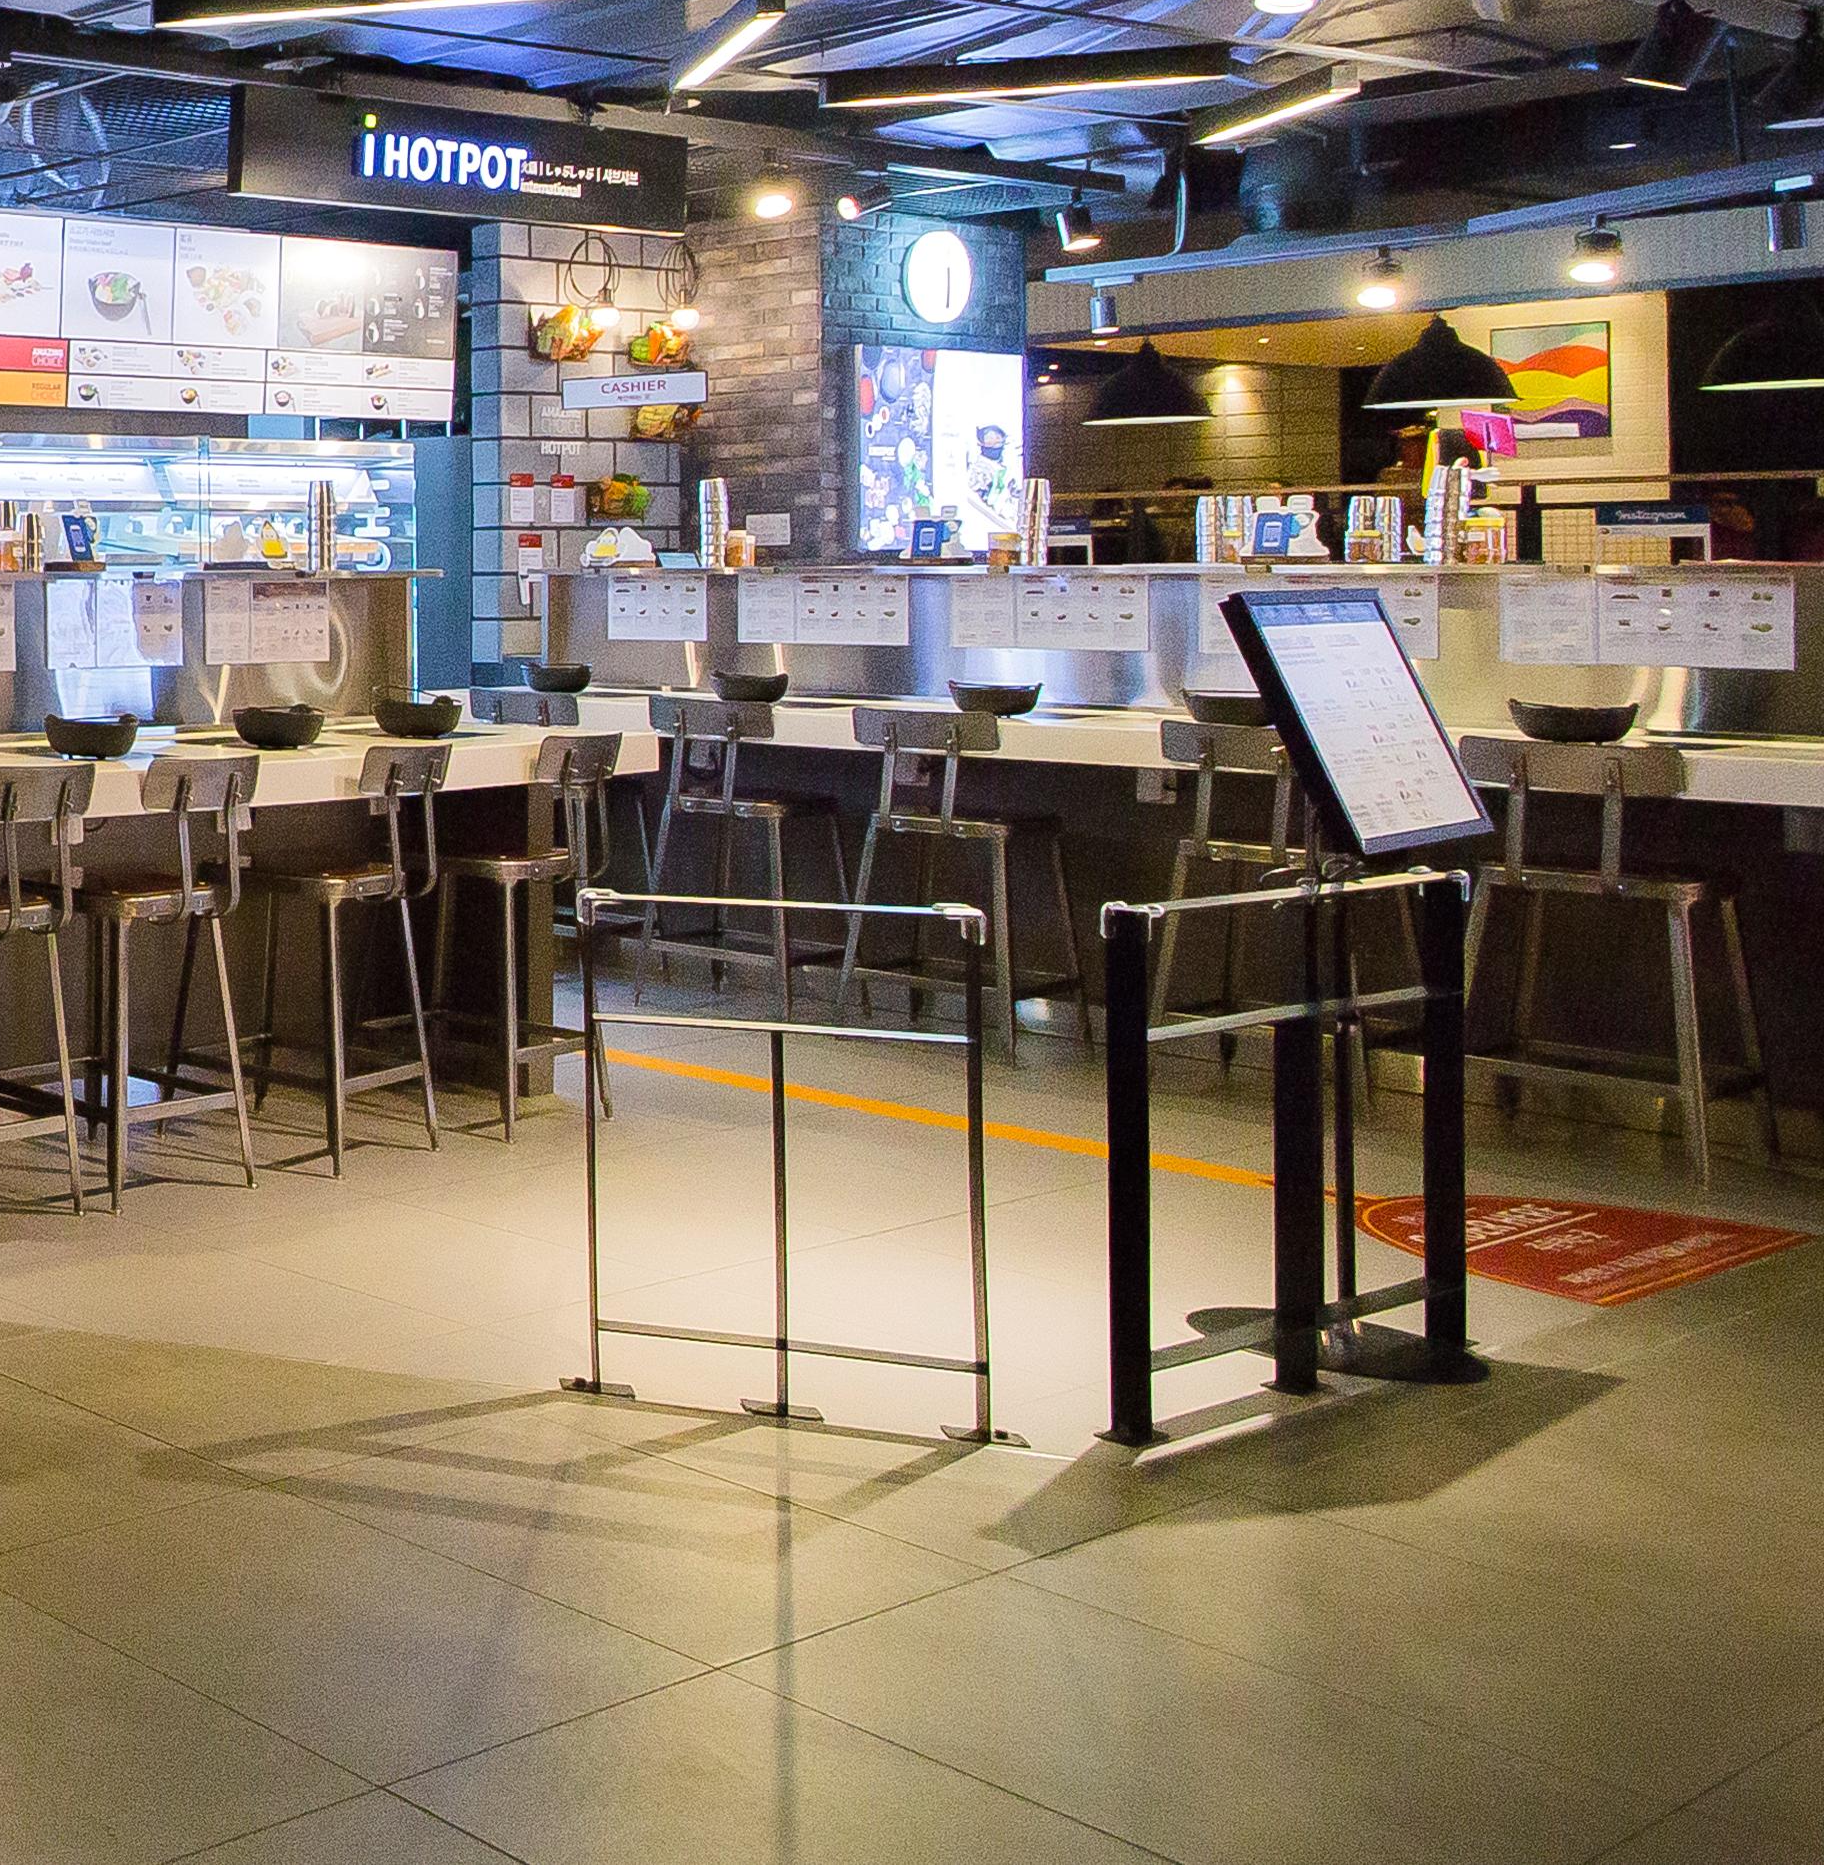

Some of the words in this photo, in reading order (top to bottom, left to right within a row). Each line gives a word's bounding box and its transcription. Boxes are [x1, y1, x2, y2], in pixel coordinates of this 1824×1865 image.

[384, 133, 528, 191] HOTPOT
[601, 379, 667, 394] CASHIER
[540, 442, 581, 455] HOTPOT
